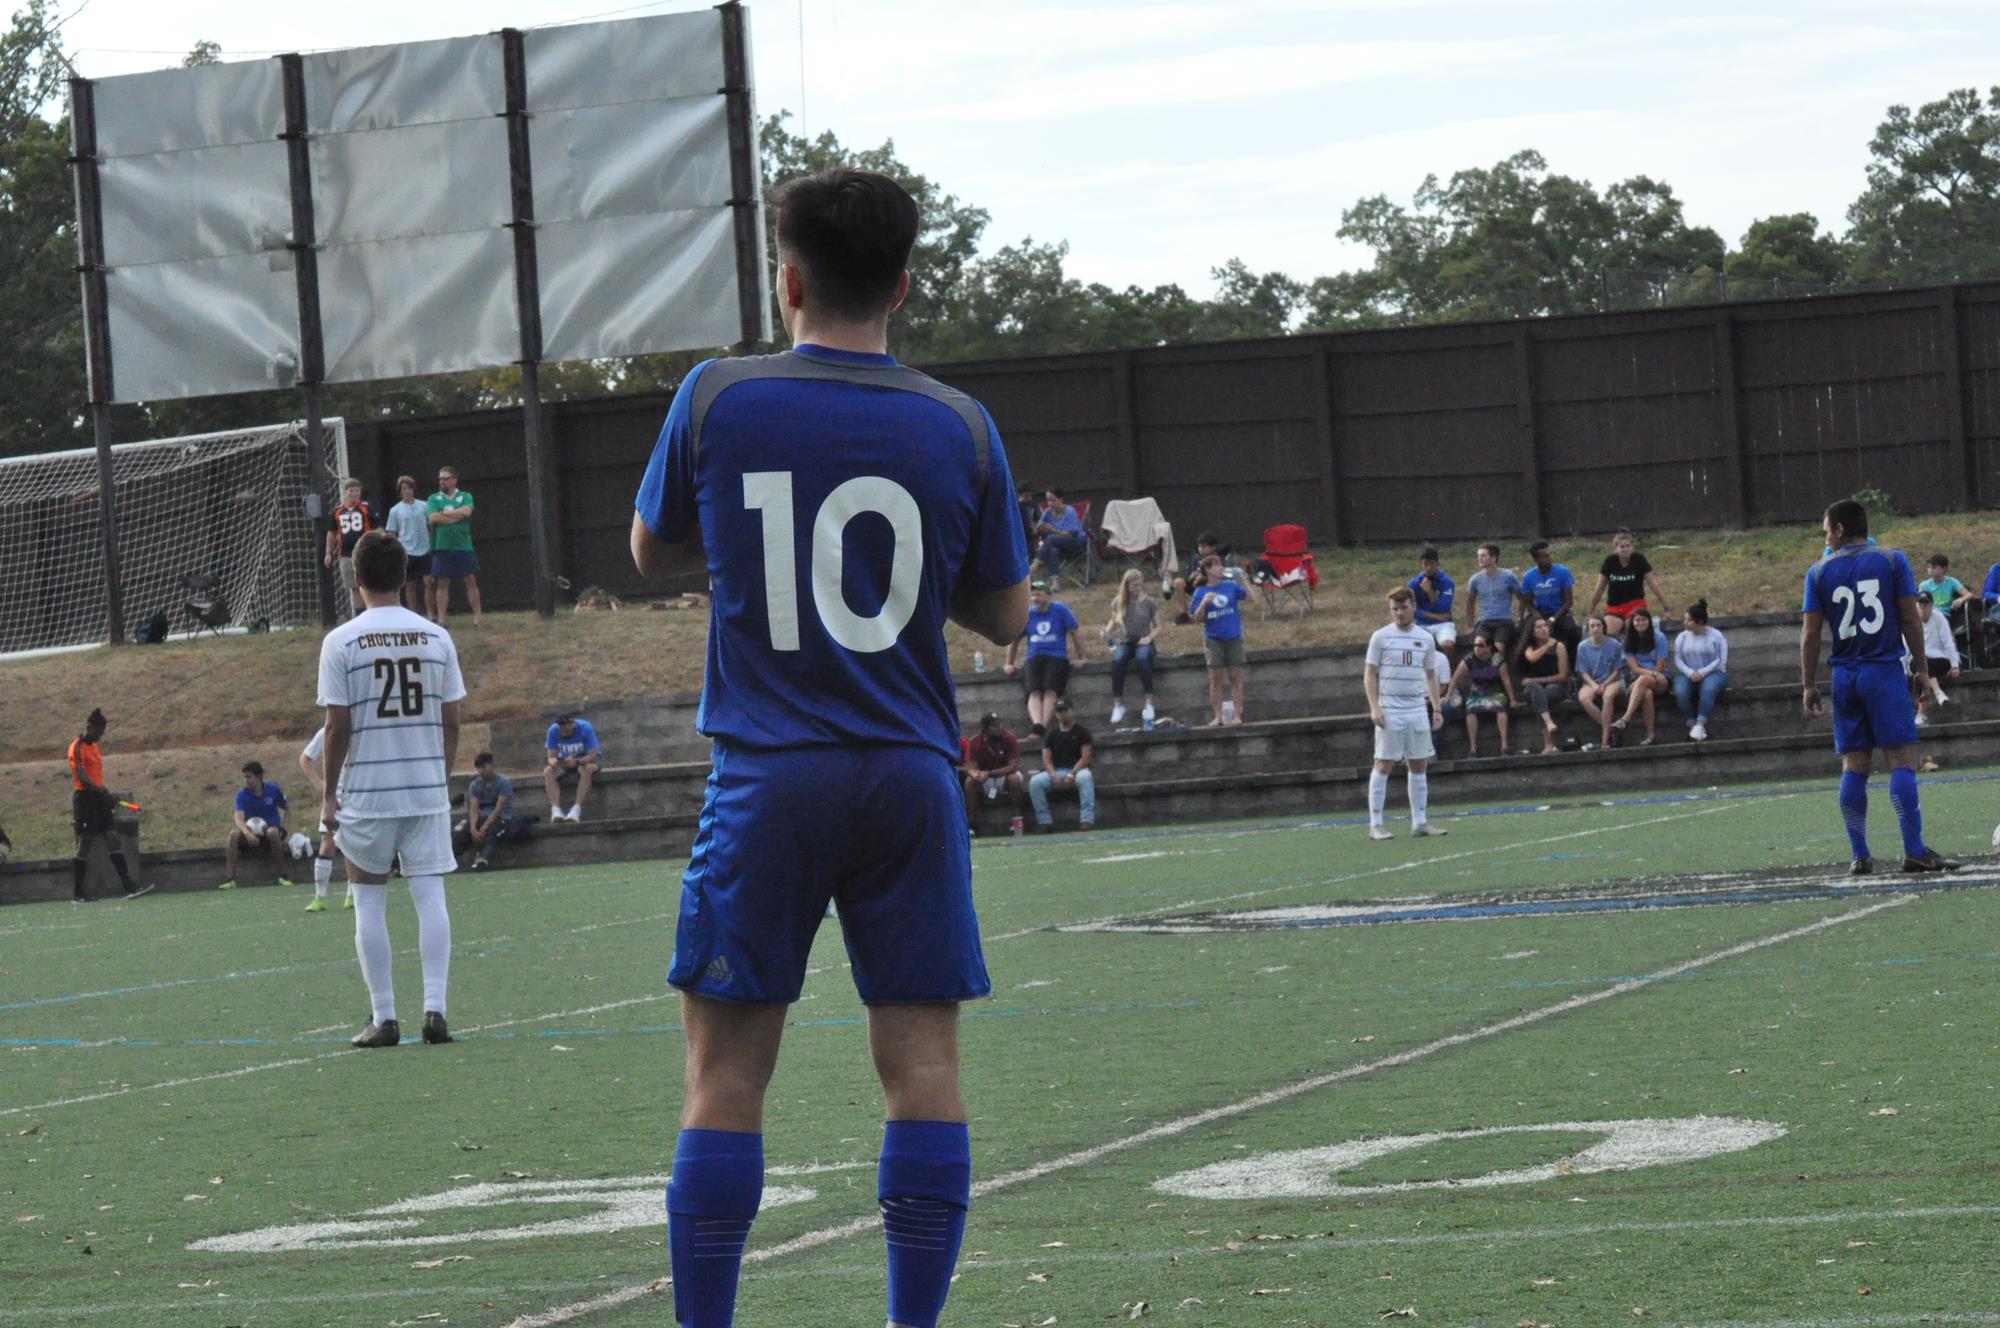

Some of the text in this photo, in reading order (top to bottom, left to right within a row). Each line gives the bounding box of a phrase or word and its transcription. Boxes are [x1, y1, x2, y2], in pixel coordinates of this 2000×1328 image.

[339, 511, 363, 534] 58
[742, 470, 924, 653] 10
[1832, 578, 1885, 641] 23
[357, 631, 429, 649] CHOCTAWS
[1402, 649, 1413, 666] 10
[374, 656, 424, 719] 26
